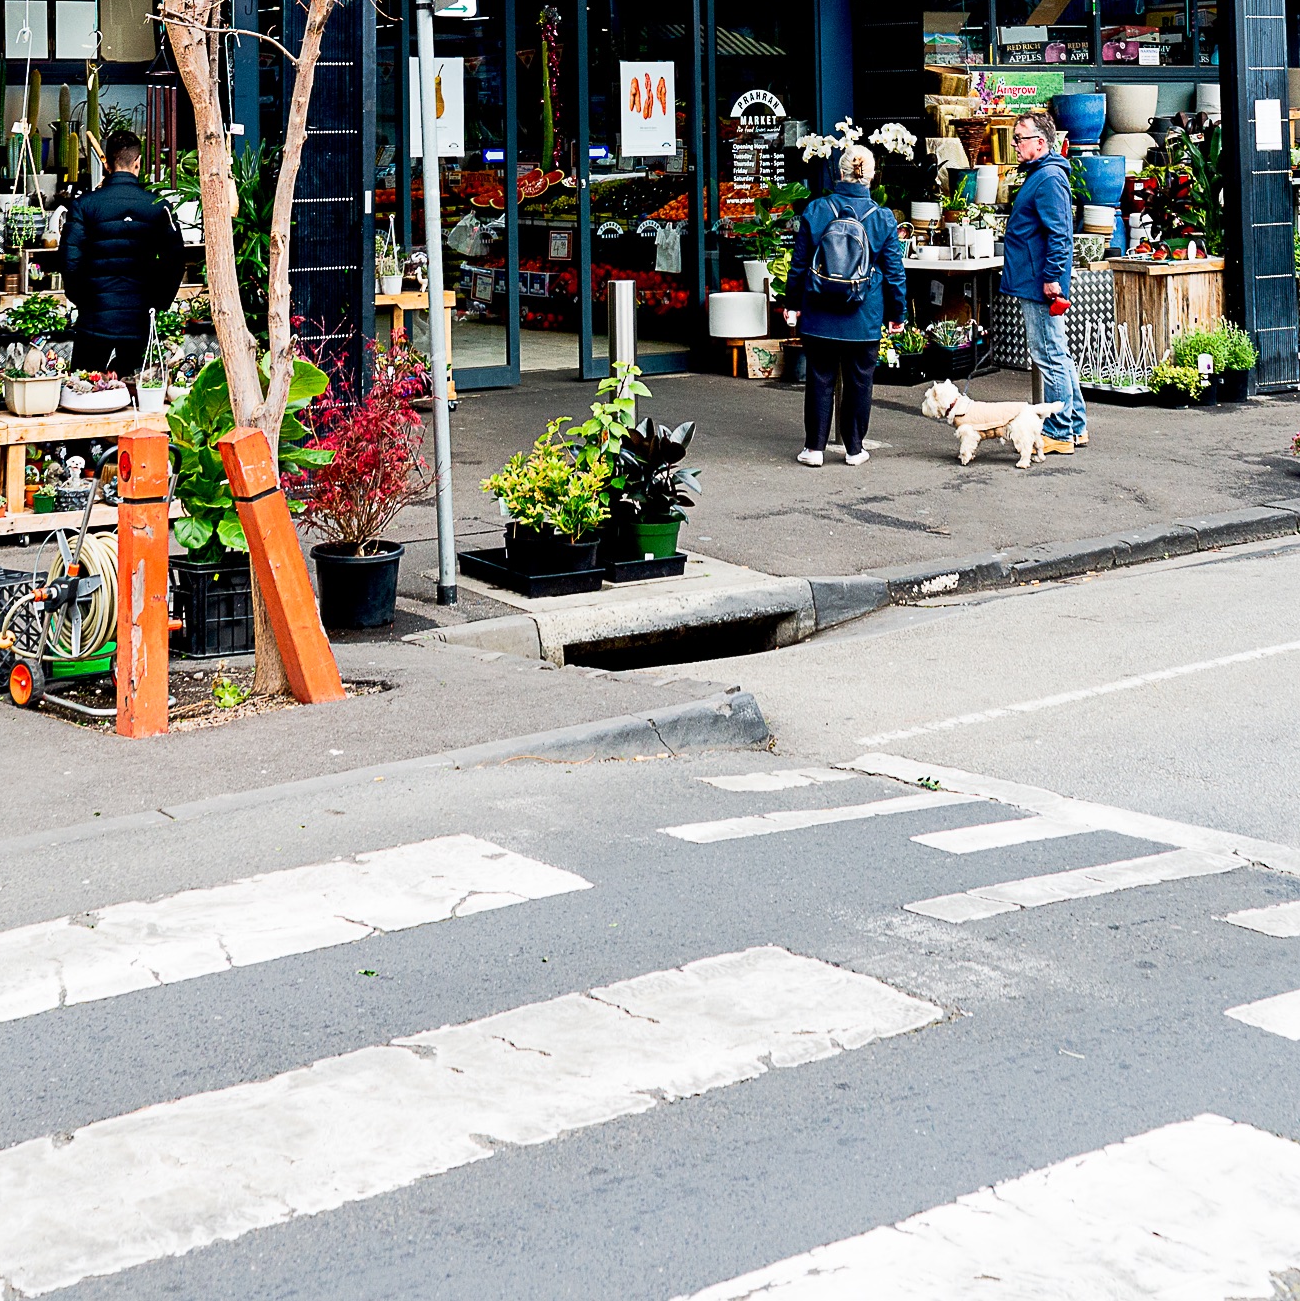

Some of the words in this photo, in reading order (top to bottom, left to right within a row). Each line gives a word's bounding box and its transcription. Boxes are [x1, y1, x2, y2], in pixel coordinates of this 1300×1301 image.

[1022, 42, 1041, 50] RICH
[1008, 53, 1042, 63] APPLES
[996, 84, 1037, 97] Amgrow
[737, 91, 780, 110] PRAHRAN
[740, 115, 777, 126] MARKET
[732, 143, 753, 151] Opening
